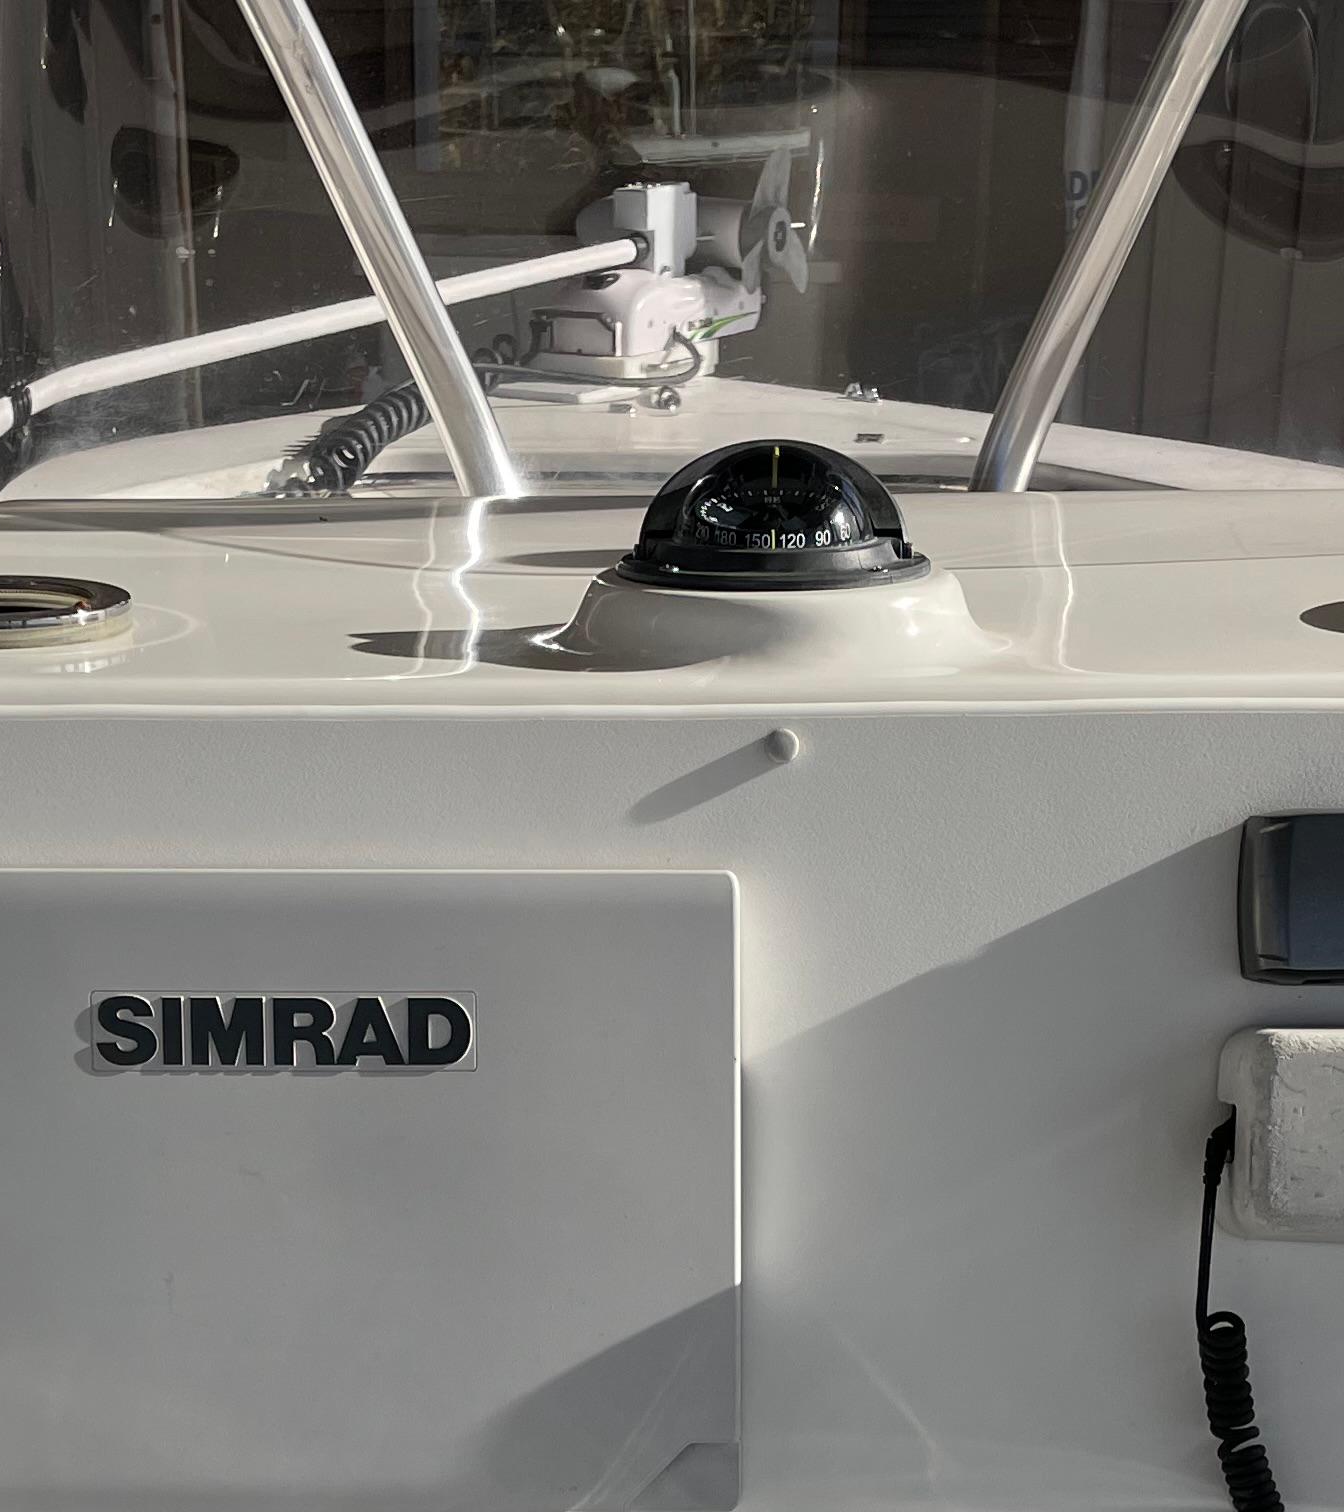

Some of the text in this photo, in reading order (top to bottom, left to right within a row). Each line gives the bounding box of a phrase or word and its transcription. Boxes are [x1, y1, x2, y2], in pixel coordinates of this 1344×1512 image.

[744, 533, 771, 549] 150
[779, 533, 806, 549] 120
[815, 531, 831, 547] 90
[840, 523, 851, 540] 60
[96, 994, 472, 1066] SIMRAD
